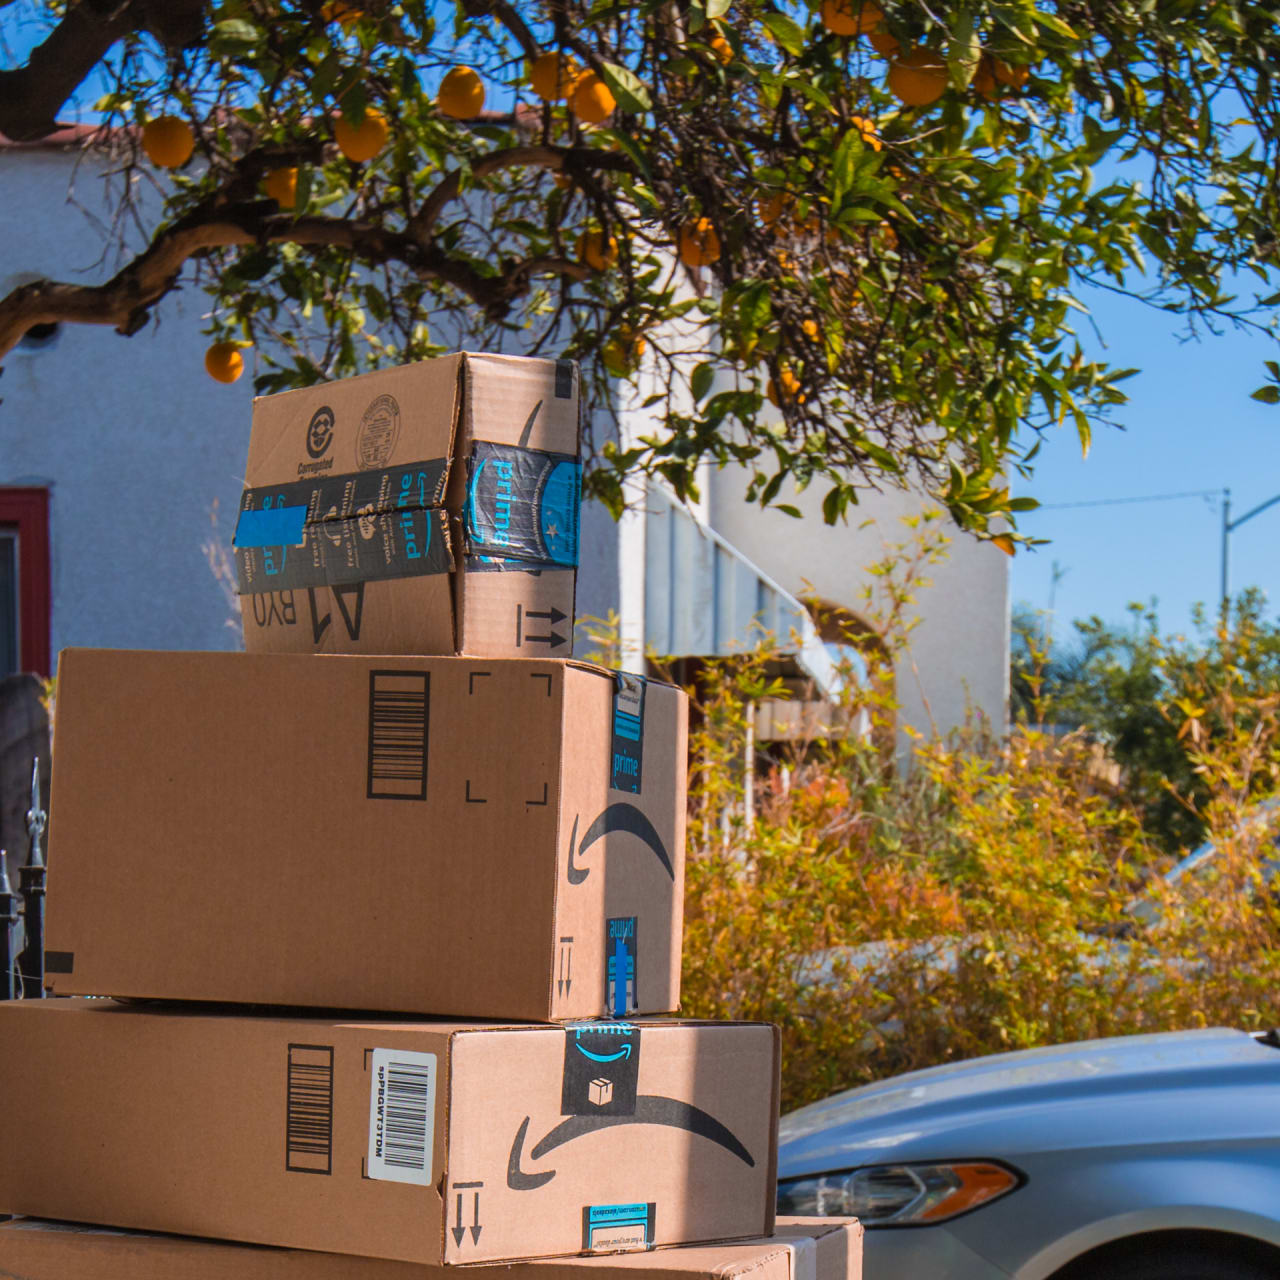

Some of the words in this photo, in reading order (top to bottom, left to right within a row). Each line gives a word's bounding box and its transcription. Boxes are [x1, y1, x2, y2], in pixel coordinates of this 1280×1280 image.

[262, 495, 279, 576] pre
[397, 472, 421, 560] prime
[492, 460, 518, 548] prime
[614, 748, 638, 777] prime
[609, 916, 634, 938] prime
